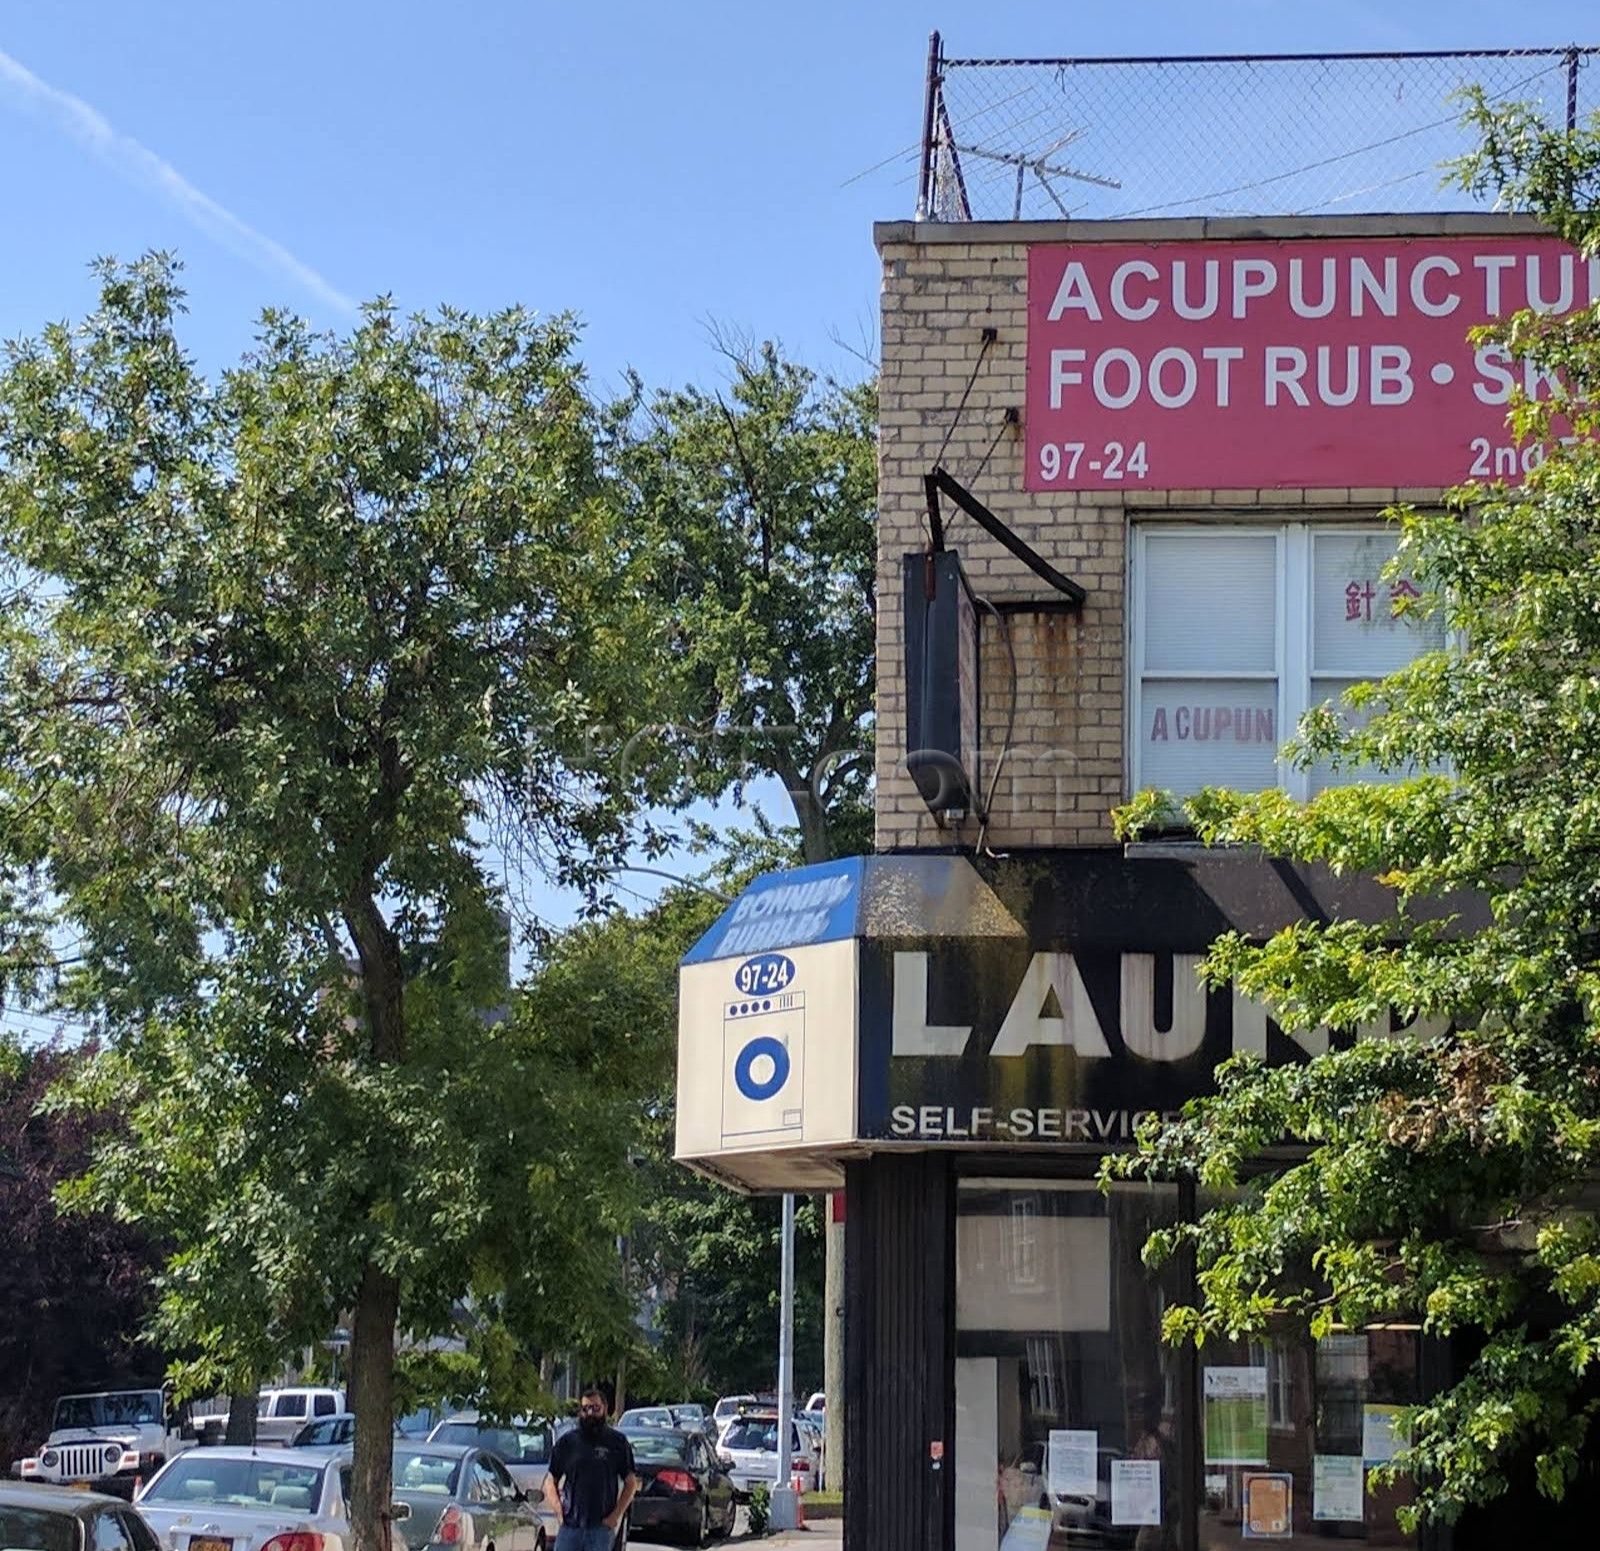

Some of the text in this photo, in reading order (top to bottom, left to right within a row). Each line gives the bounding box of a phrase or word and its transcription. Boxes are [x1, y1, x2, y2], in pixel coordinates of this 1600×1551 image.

[1046, 254, 1600, 321] ACUPUNCTU
[1049, 346, 1245, 410] FOOT
[1263, 344, 1416, 407] RUB
[1039, 441, 1150, 482] 97-24
[1150, 705, 1275, 742] ACUPUN
[740, 960, 789, 992] 97-24
